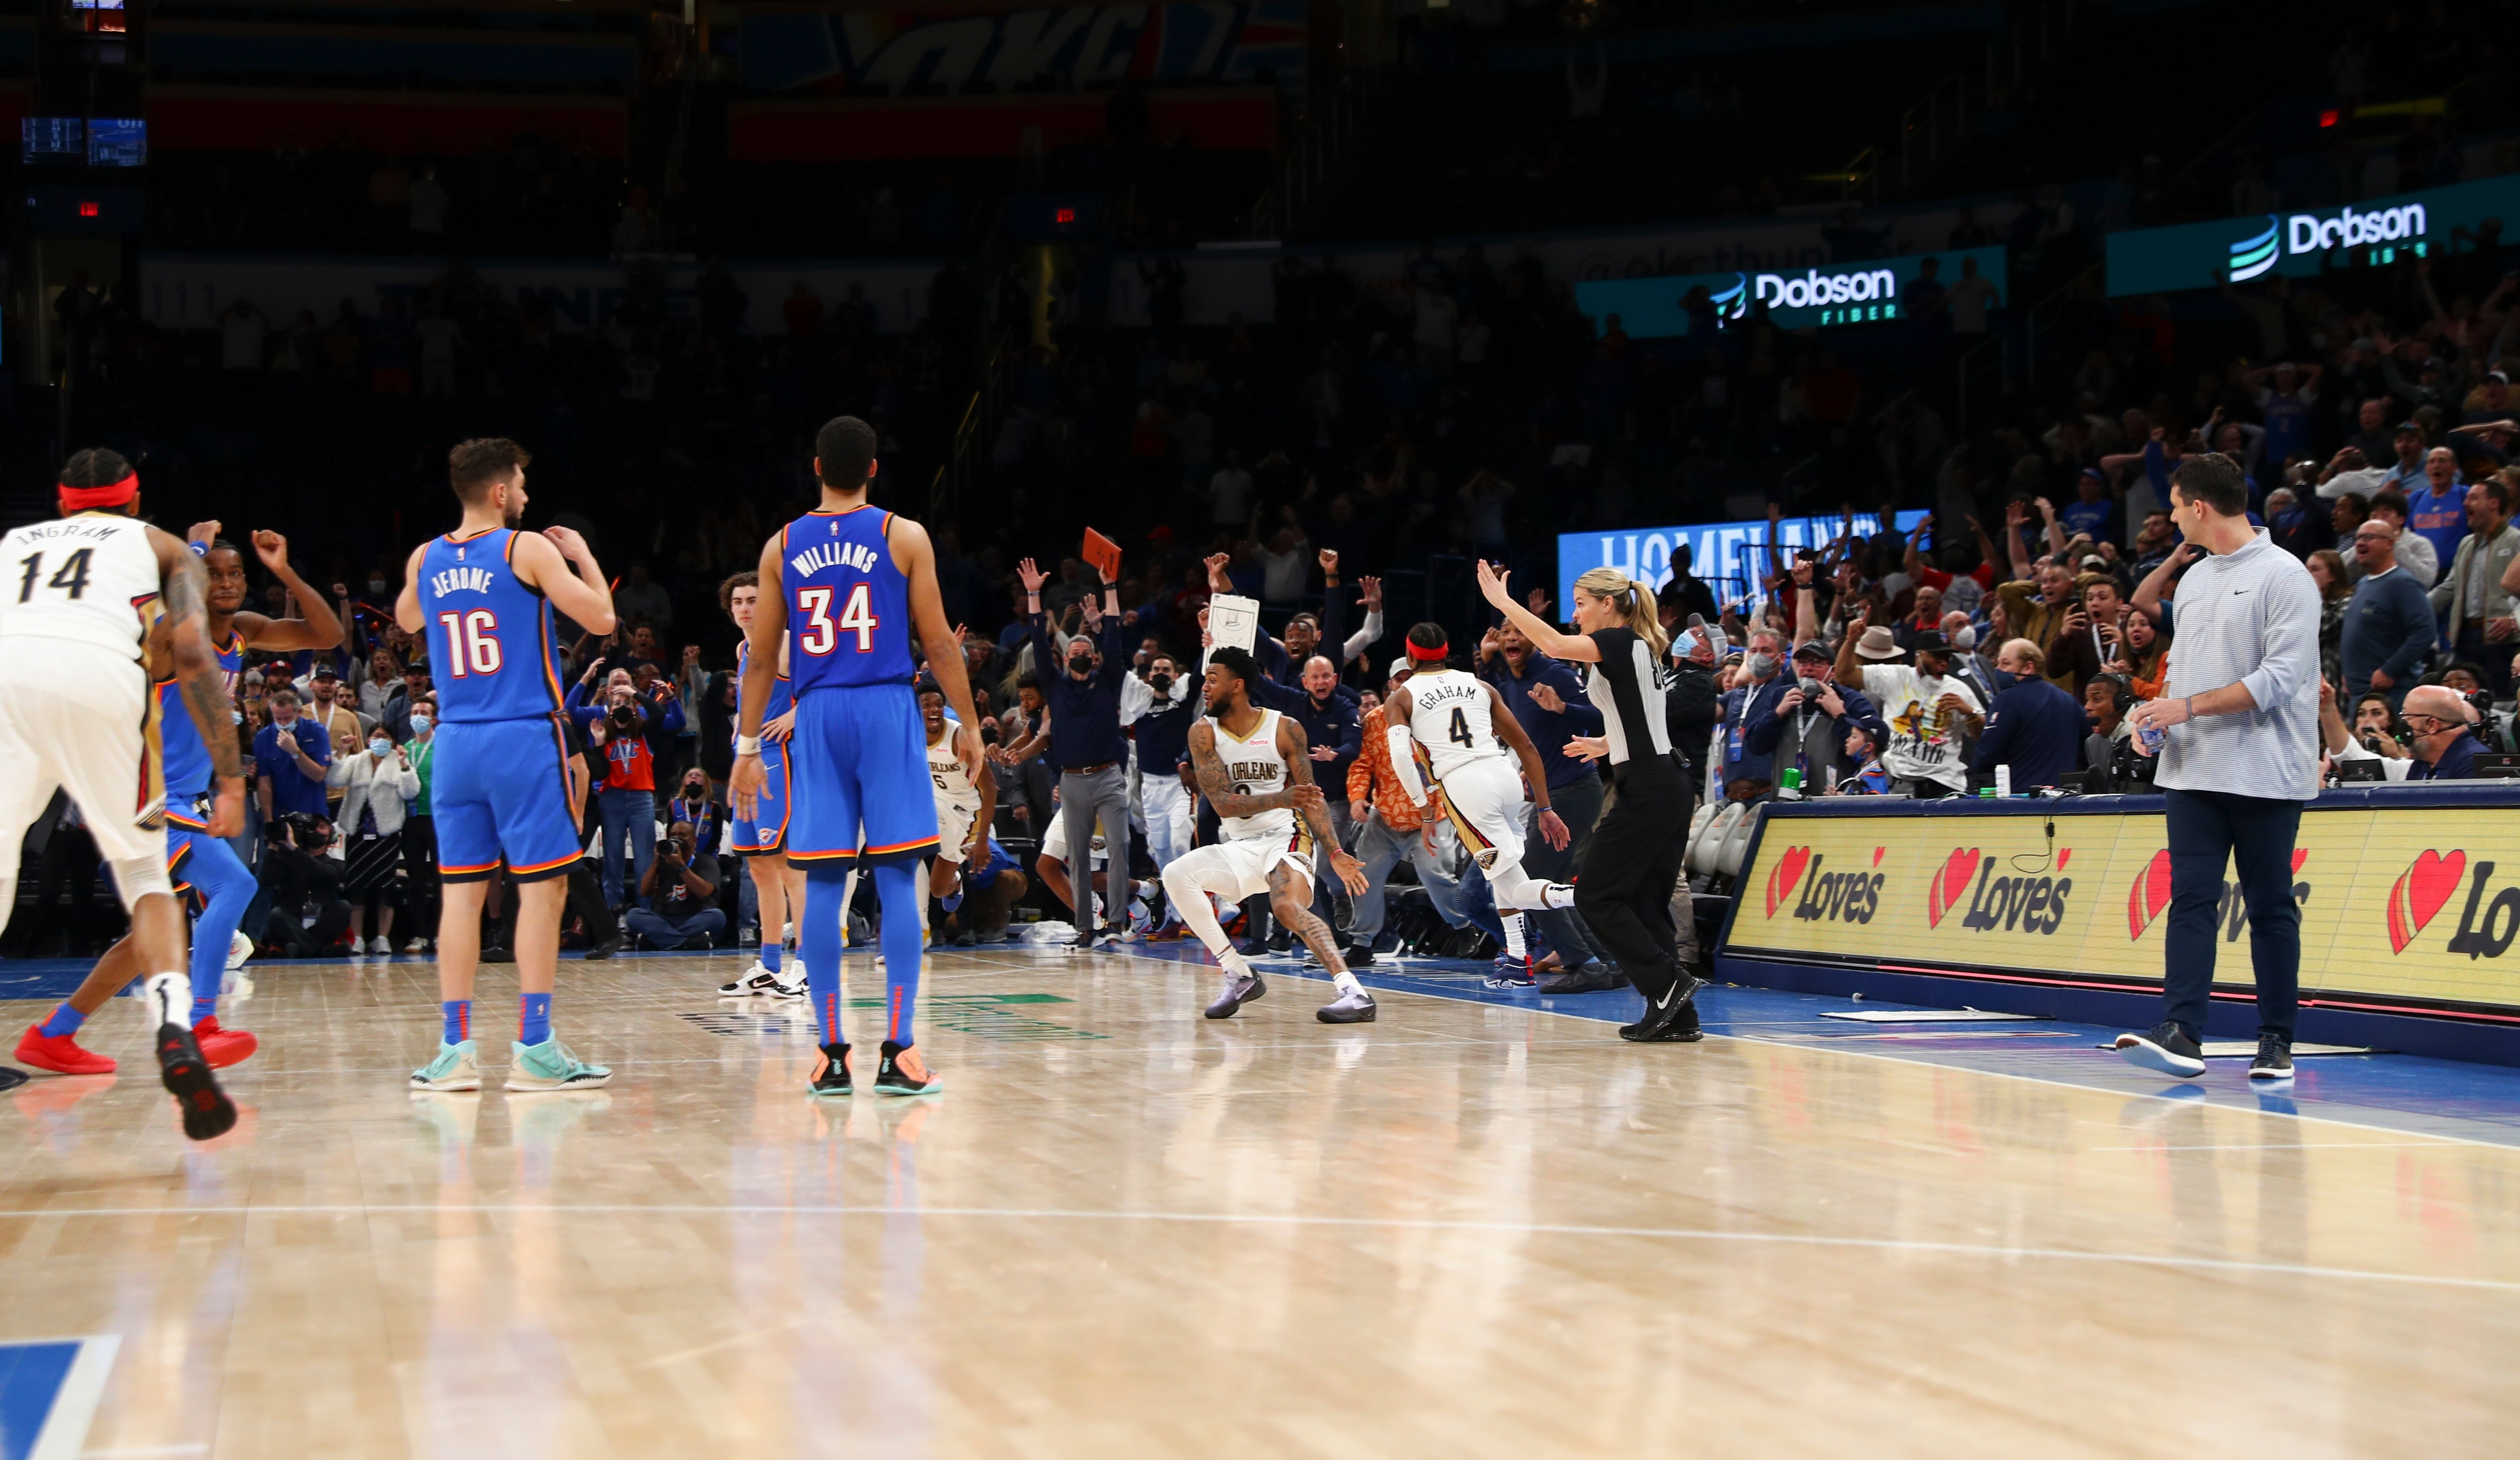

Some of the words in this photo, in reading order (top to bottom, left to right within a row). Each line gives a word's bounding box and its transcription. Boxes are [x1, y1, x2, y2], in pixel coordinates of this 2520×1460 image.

[2288, 203, 2426, 254] Dobson
[1755, 269, 1895, 310] Dobson
[1821, 304, 1897, 325] FIBER
[16, 525, 121, 546] INGRAM
[19, 547, 95, 604] 14
[791, 541, 878, 578] WILLIAMS
[431, 567, 494, 598] JEROME
[796, 582, 879, 657] 34
[439, 607, 503, 679] 16
[1419, 684, 1477, 710] GRAHAM
[1449, 707, 1474, 749] 4
[609, 742, 640, 762] OC
[932, 774, 948, 789] 5
[1232, 762, 1278, 781] ORLEANS
